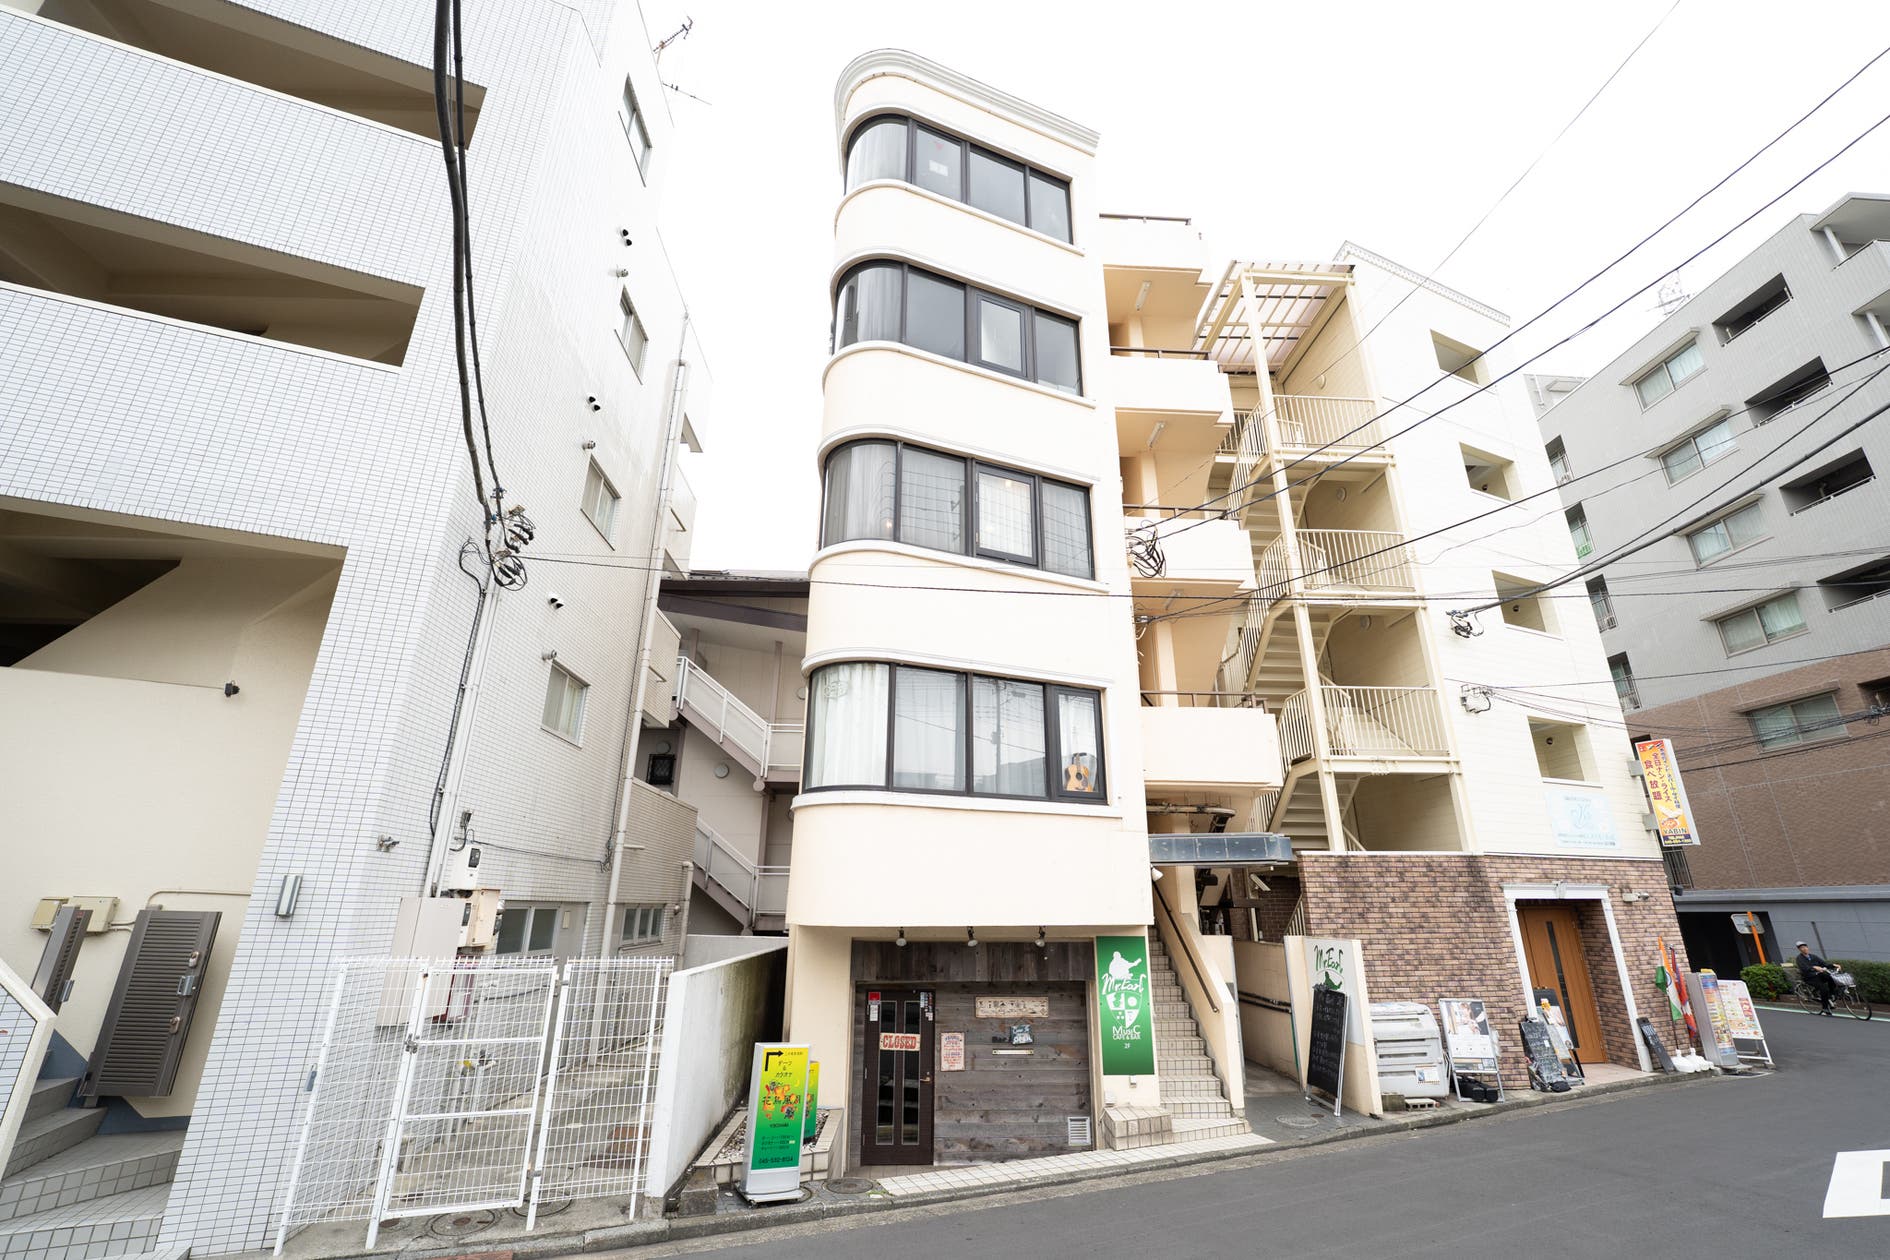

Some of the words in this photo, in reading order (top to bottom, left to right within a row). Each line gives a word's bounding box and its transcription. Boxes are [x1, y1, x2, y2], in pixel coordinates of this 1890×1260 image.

[1644, 760, 1662, 800] 食べ放題
[882, 1035, 917, 1049] CLOSED
